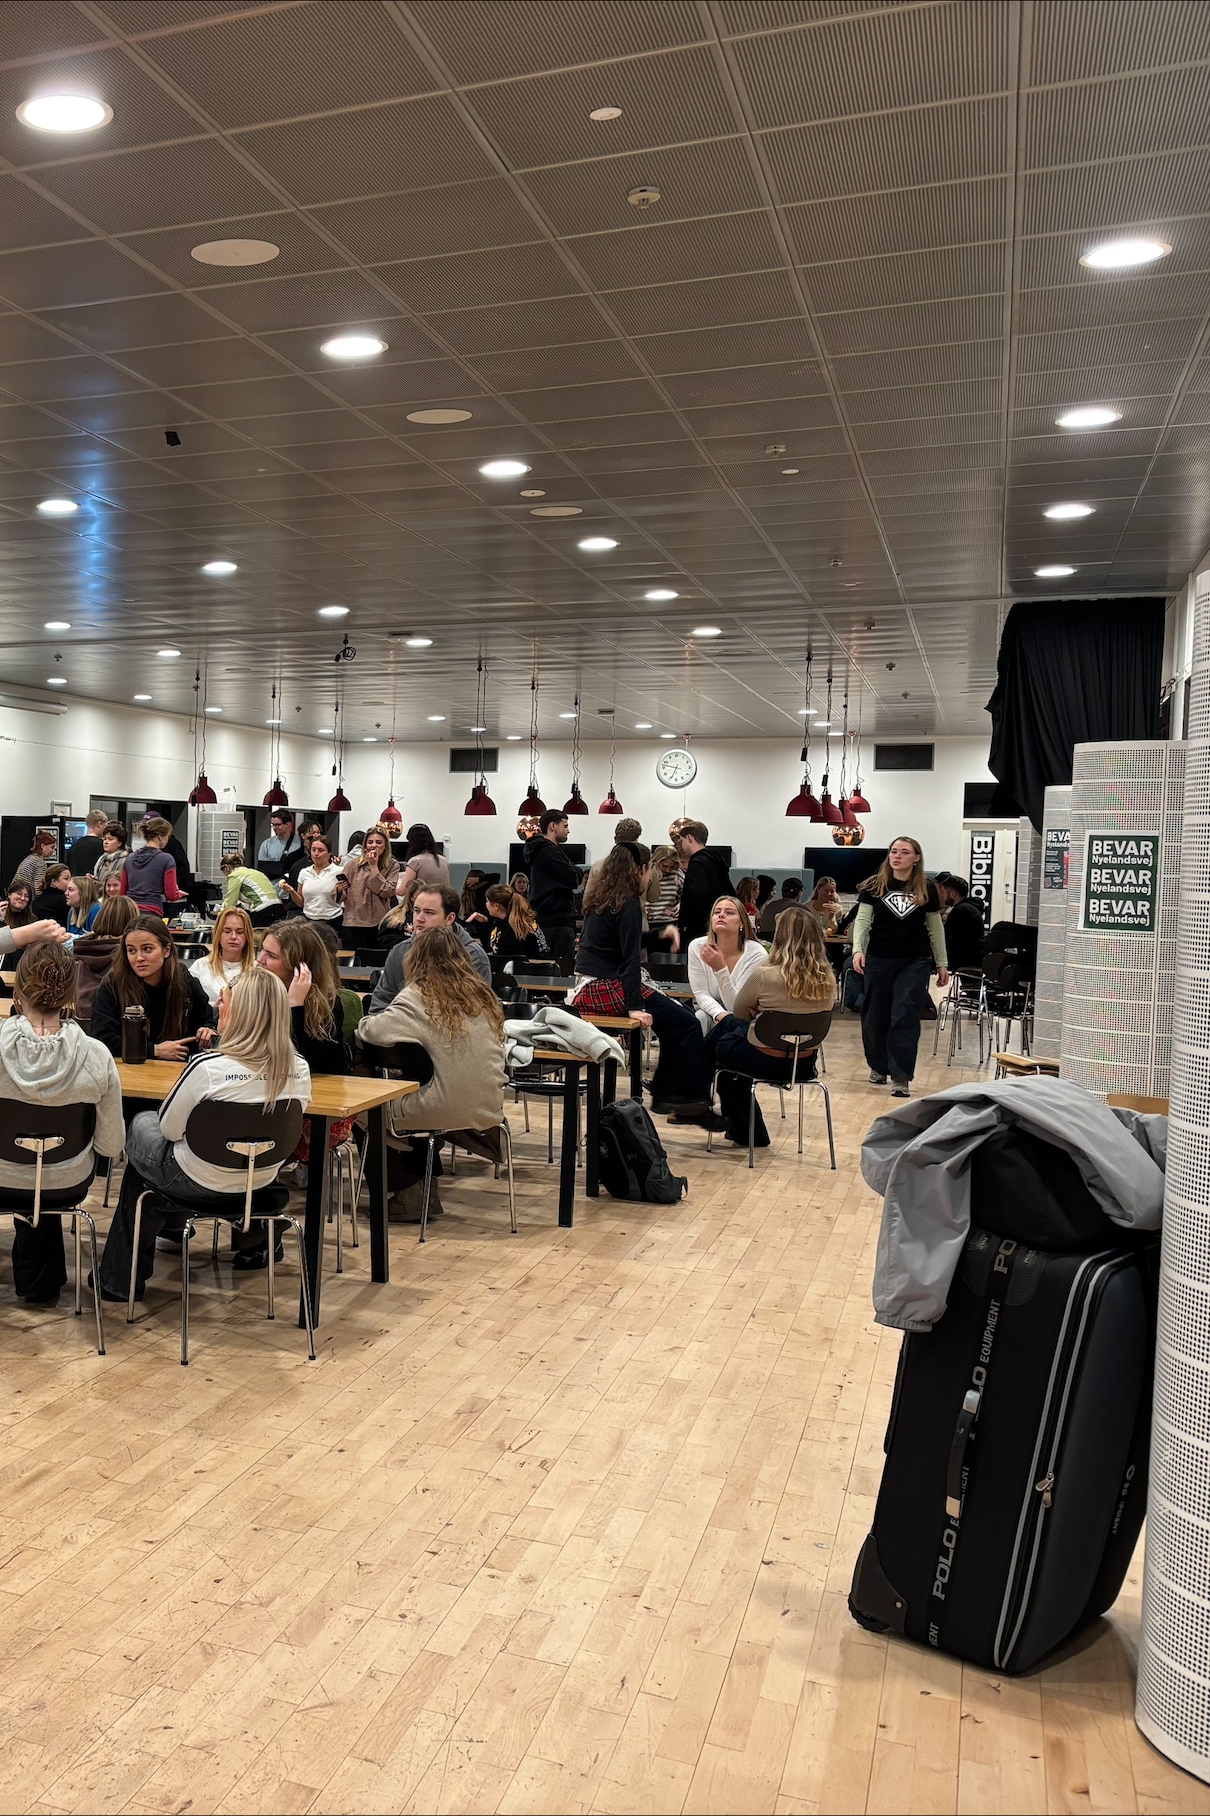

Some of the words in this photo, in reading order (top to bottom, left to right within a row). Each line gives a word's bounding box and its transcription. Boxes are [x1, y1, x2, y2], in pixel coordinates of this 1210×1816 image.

[1092, 840, 1154, 856] BEVAR
[1091, 855, 1153, 867] Nyelandsvej
[1090, 868, 1152, 885] BEVAR
[1090, 883, 1152, 896] Nyelandsvej
[1089, 898, 1150, 916] BEVAR
[1089, 913, 1150, 927] Nyelandsvej
[979, 1298, 1001, 1364] EQUIPMENT
[932, 1527, 957, 1601] POLO
